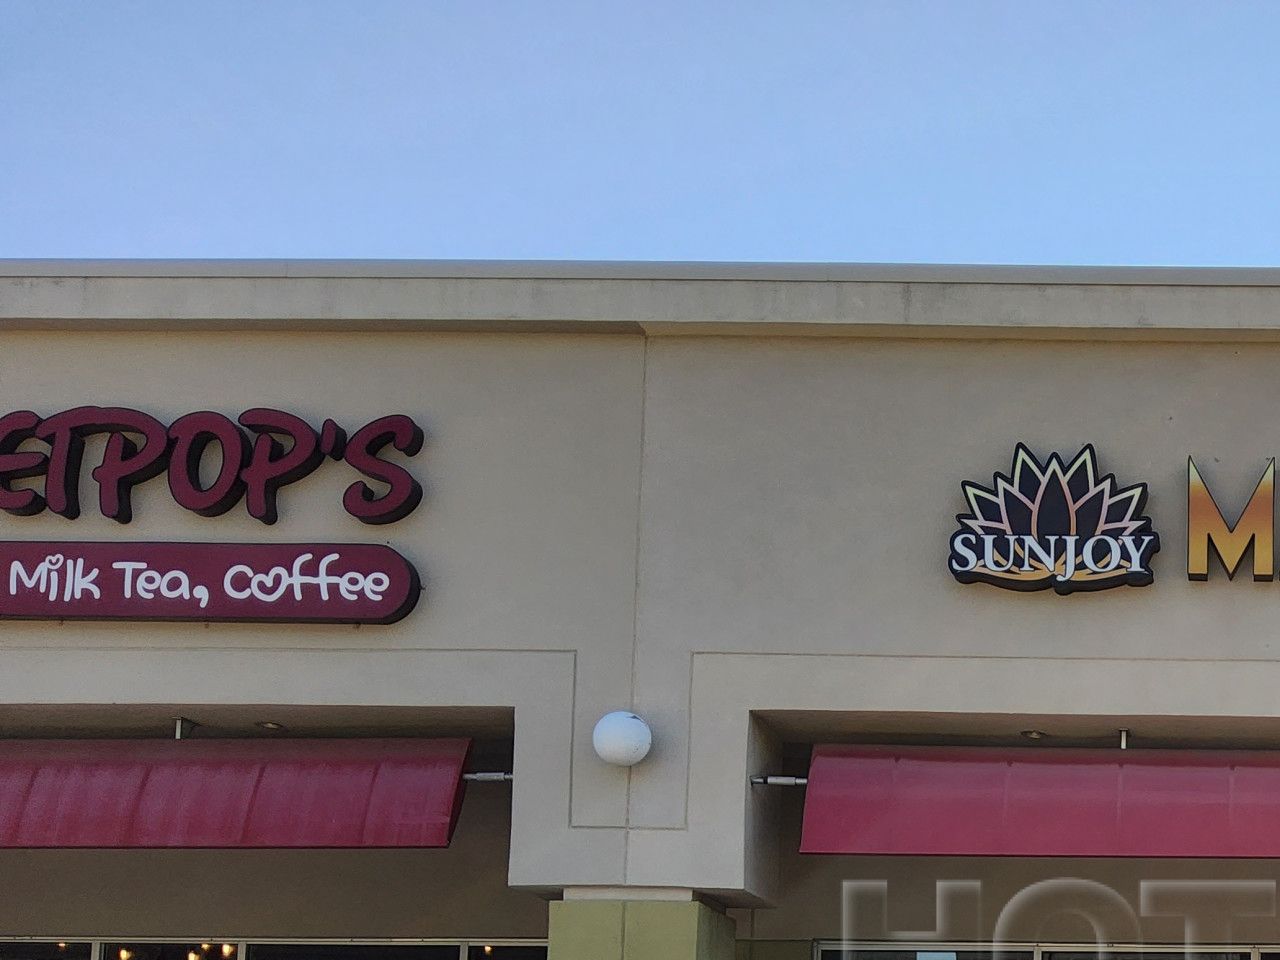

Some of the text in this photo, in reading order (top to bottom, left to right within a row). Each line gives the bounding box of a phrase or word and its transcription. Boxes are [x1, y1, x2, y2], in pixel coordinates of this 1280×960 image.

[9, 553, 101, 602] Milk
[112, 561, 209, 608] Tea,
[951, 533, 1154, 582] SUNJOY
